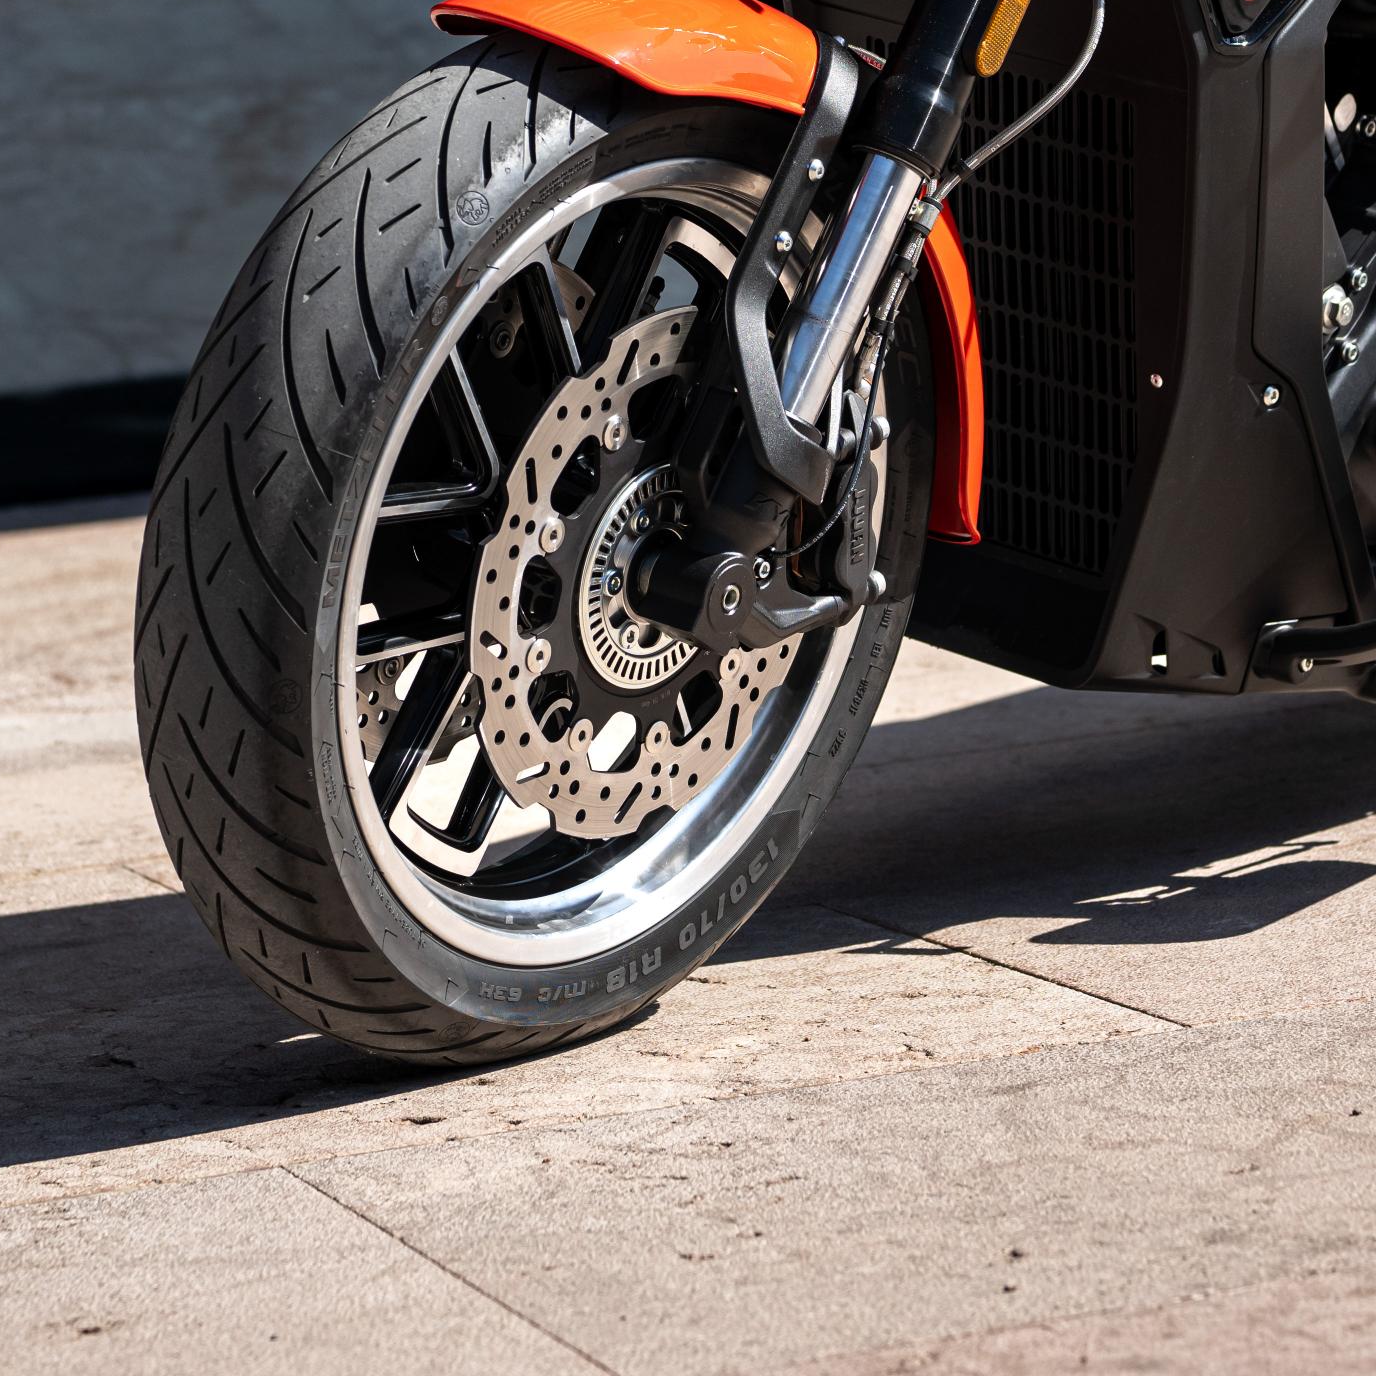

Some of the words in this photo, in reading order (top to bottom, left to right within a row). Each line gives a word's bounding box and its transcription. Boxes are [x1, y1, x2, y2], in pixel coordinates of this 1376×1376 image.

[320, 336, 426, 609] METZELER
[678, 837, 780, 952] 130/70
[604, 944, 662, 994] R18
